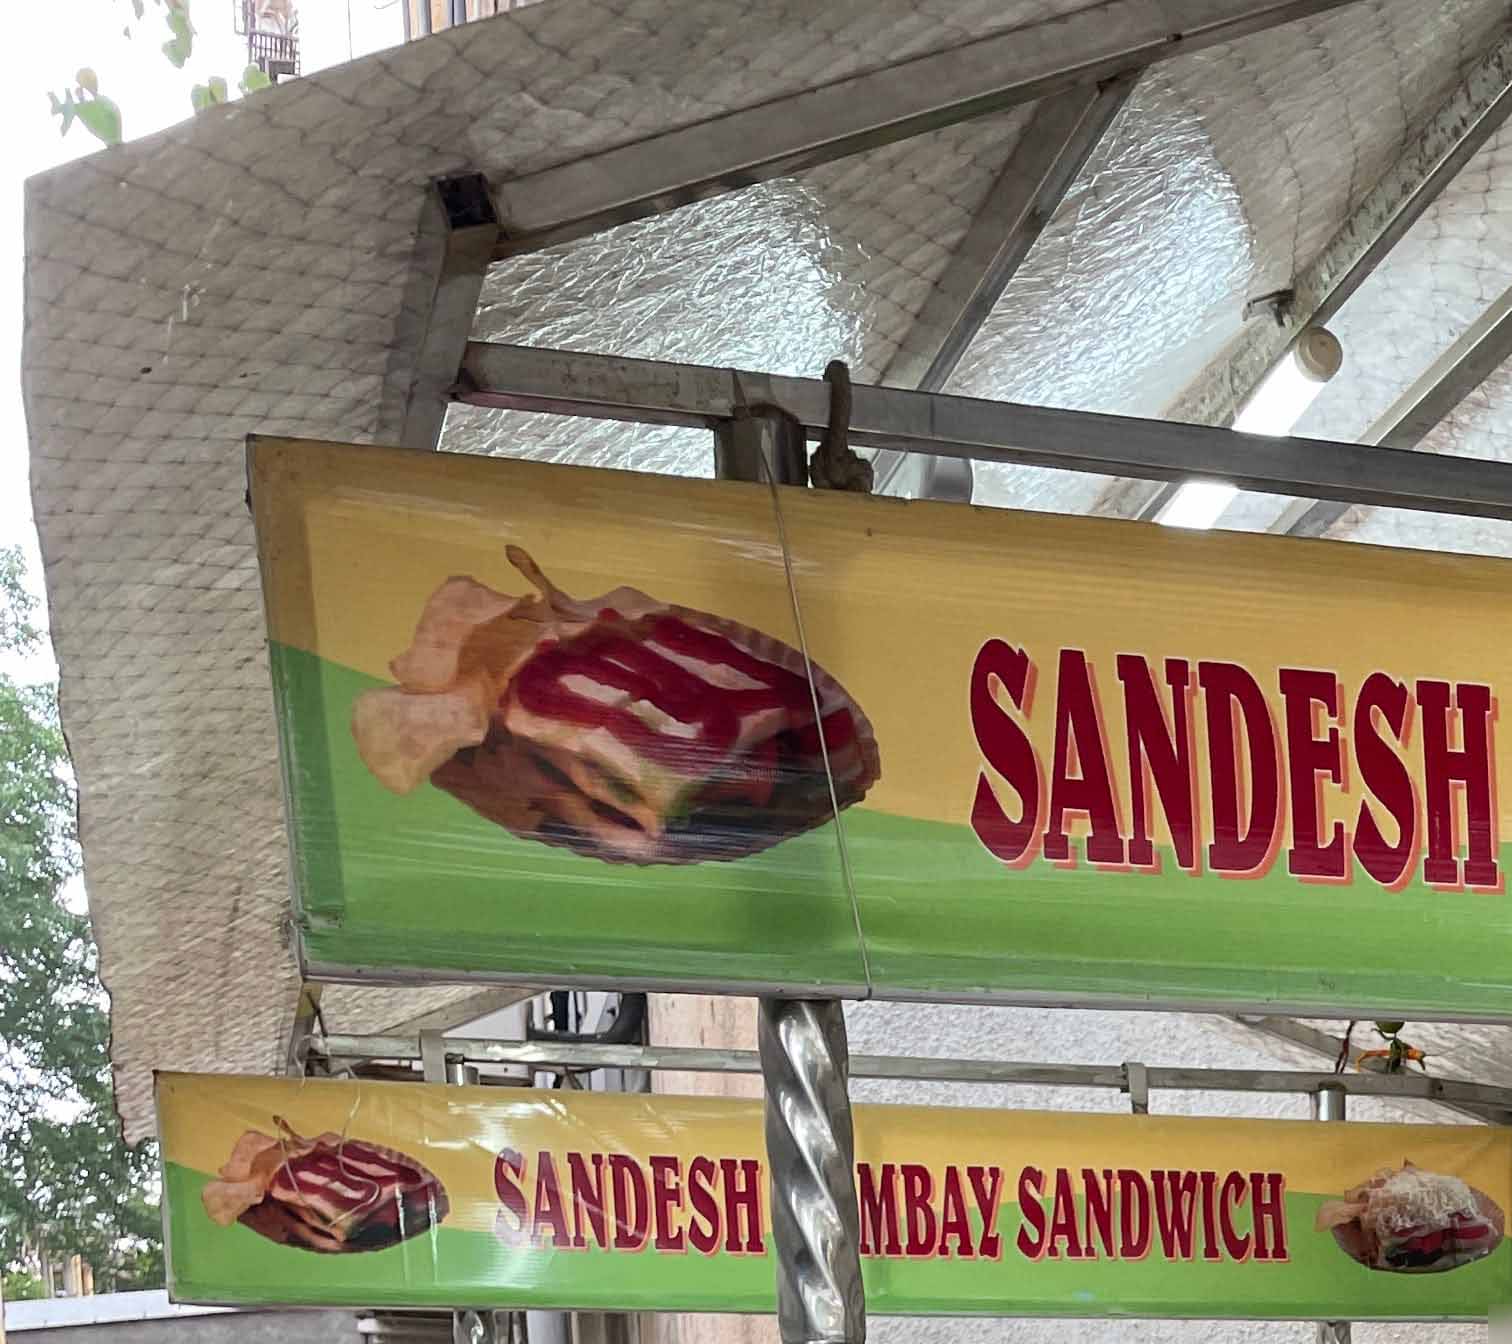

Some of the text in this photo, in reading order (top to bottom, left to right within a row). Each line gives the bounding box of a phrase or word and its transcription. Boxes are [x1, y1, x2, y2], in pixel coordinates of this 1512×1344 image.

[969, 637, 1506, 895] SANDESH
[494, 1146, 1290, 1263] SANDESH MBAY SANDWICH
